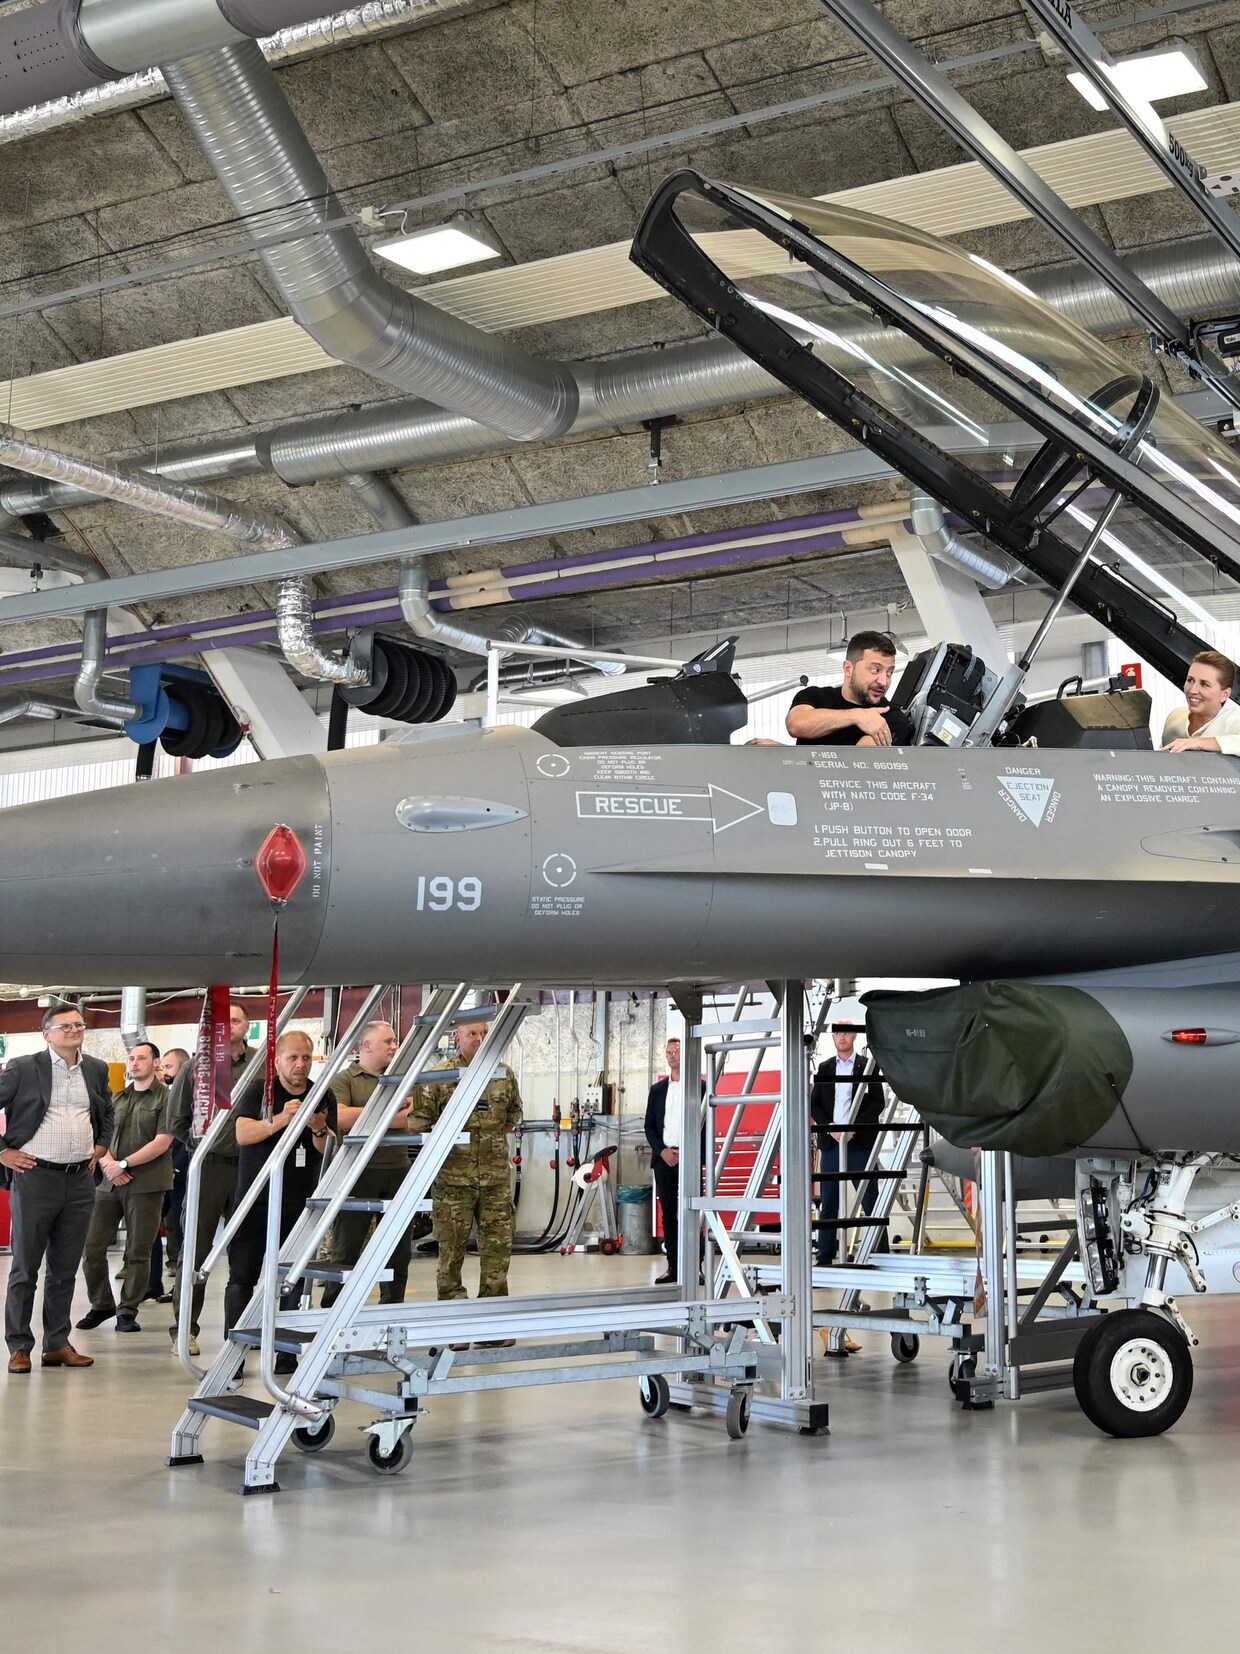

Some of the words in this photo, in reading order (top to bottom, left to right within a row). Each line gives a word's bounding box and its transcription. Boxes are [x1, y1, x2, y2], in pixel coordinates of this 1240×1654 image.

[814, 761, 848, 769] SERIAL
[853, 762, 870, 770] NO.
[1005, 766, 1041, 776] DANGER
[819, 779, 862, 789] SERVICE
[866, 780, 888, 790] THIS
[892, 781, 937, 790] AIRCRAFT
[1159, 775, 1197, 784] AIRCRAFT
[1201, 776, 1240, 785] CONTAINS
[1007, 782, 1049, 792] EJECTION
[1106, 784, 1139, 792] CANOPY
[1144, 785, 1184, 793] REMOVER
[1188, 786, 1236, 794] CONTAINING
[821, 790, 846, 800] WITH
[851, 791, 876, 800] NATO
[880, 792, 907, 801] CODE
[911, 793, 934, 801] F-34
[1019, 793, 1041, 802] SEAT
[1100, 794, 1111, 802] AN
[1166, 795, 1199, 803] CHARGE
[595, 797, 683, 815] RESCUE
[824, 802, 854, 812] (JP-8)
[998, 789, 1027, 823] DANGER
[1045, 790, 1061, 823] DANGER
[854, 825, 892, 835] BUTTON
[897, 827, 910, 836] TO
[915, 827, 941, 837] OPEN
[946, 828, 972, 837] DOOR
[314, 824, 323, 855] PAINT
[853, 838, 877, 847] RING
[882, 838, 901, 847] OUT
[907, 839, 914, 847] 6
[919, 839, 944, 848] FEET
[950, 839, 962, 848] TO
[825, 849, 873, 858] JETTISON
[877, 850, 917, 858] CANOPY
[313, 860, 322, 879] NOT
[312, 884, 321, 898] DO
[416, 876, 482, 911] 199
[199, 1036, 211, 1078] BEFORE
